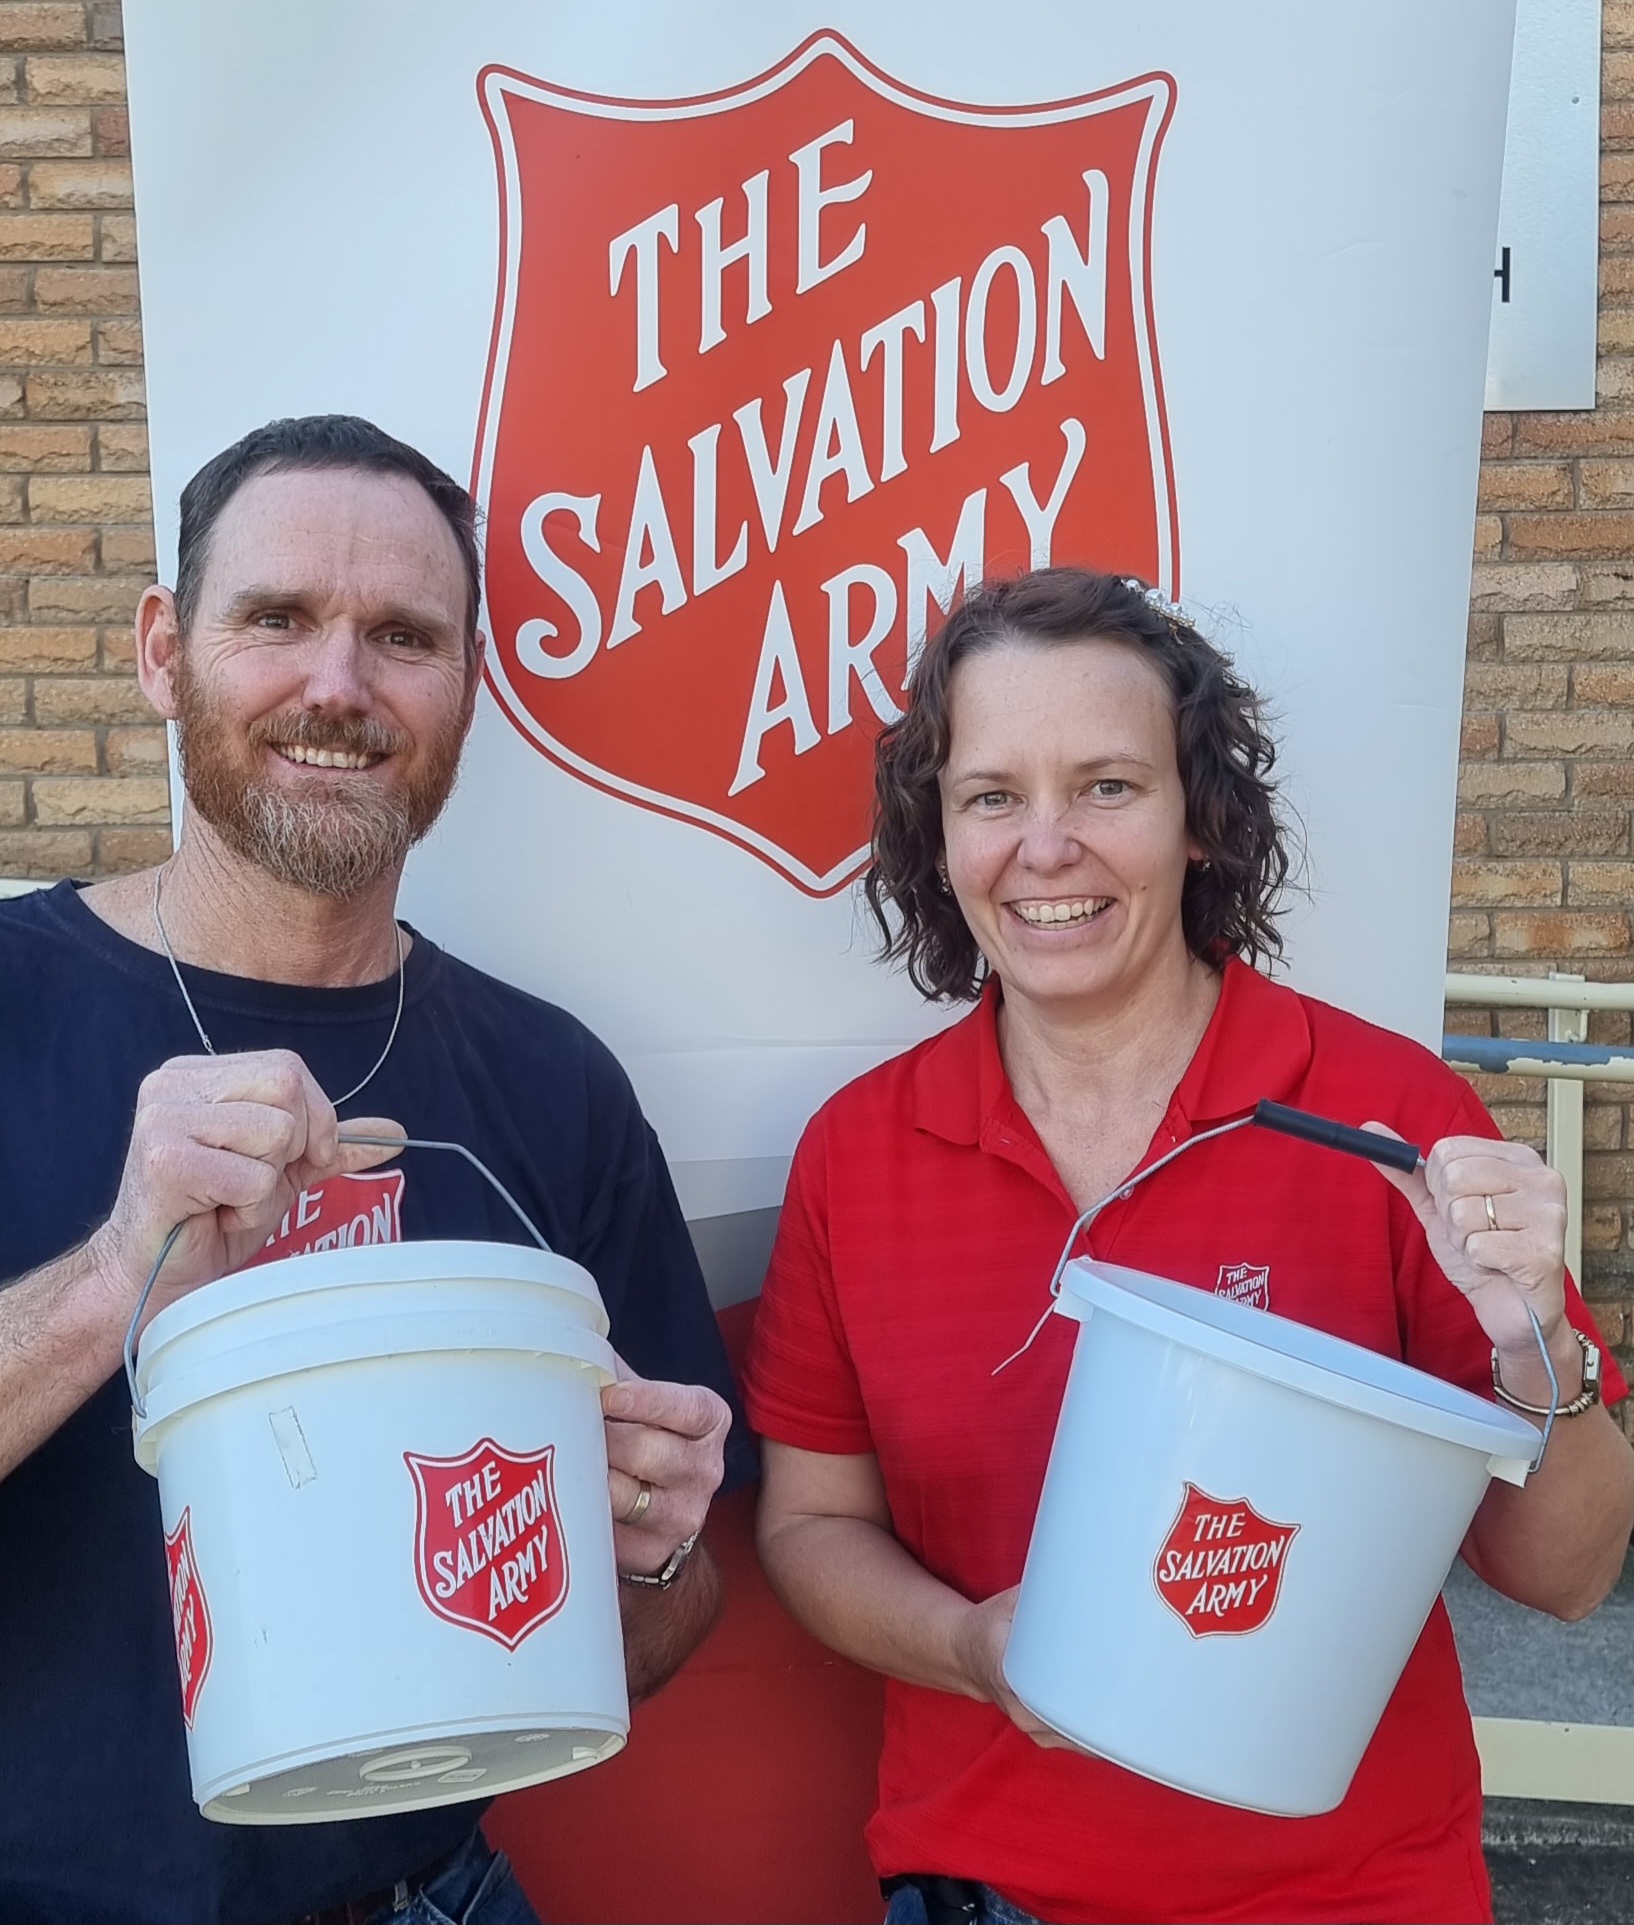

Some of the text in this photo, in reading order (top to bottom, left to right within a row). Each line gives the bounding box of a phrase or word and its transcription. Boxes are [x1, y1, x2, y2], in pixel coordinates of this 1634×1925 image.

[610, 119, 873, 392] THE
[516, 169, 1109, 680] SALVATION
[729, 417, 1087, 798] ARMY
[1226, 1267, 1248, 1285] THE
[433, 1469, 548, 1599] SALVATION
[445, 1460, 502, 1528] THE
[1193, 1512, 1246, 1542] THE
[488, 1524, 548, 1622] ARMY
[1159, 1535, 1285, 1583] SALVATION
[1185, 1574, 1268, 1617] ARMY
